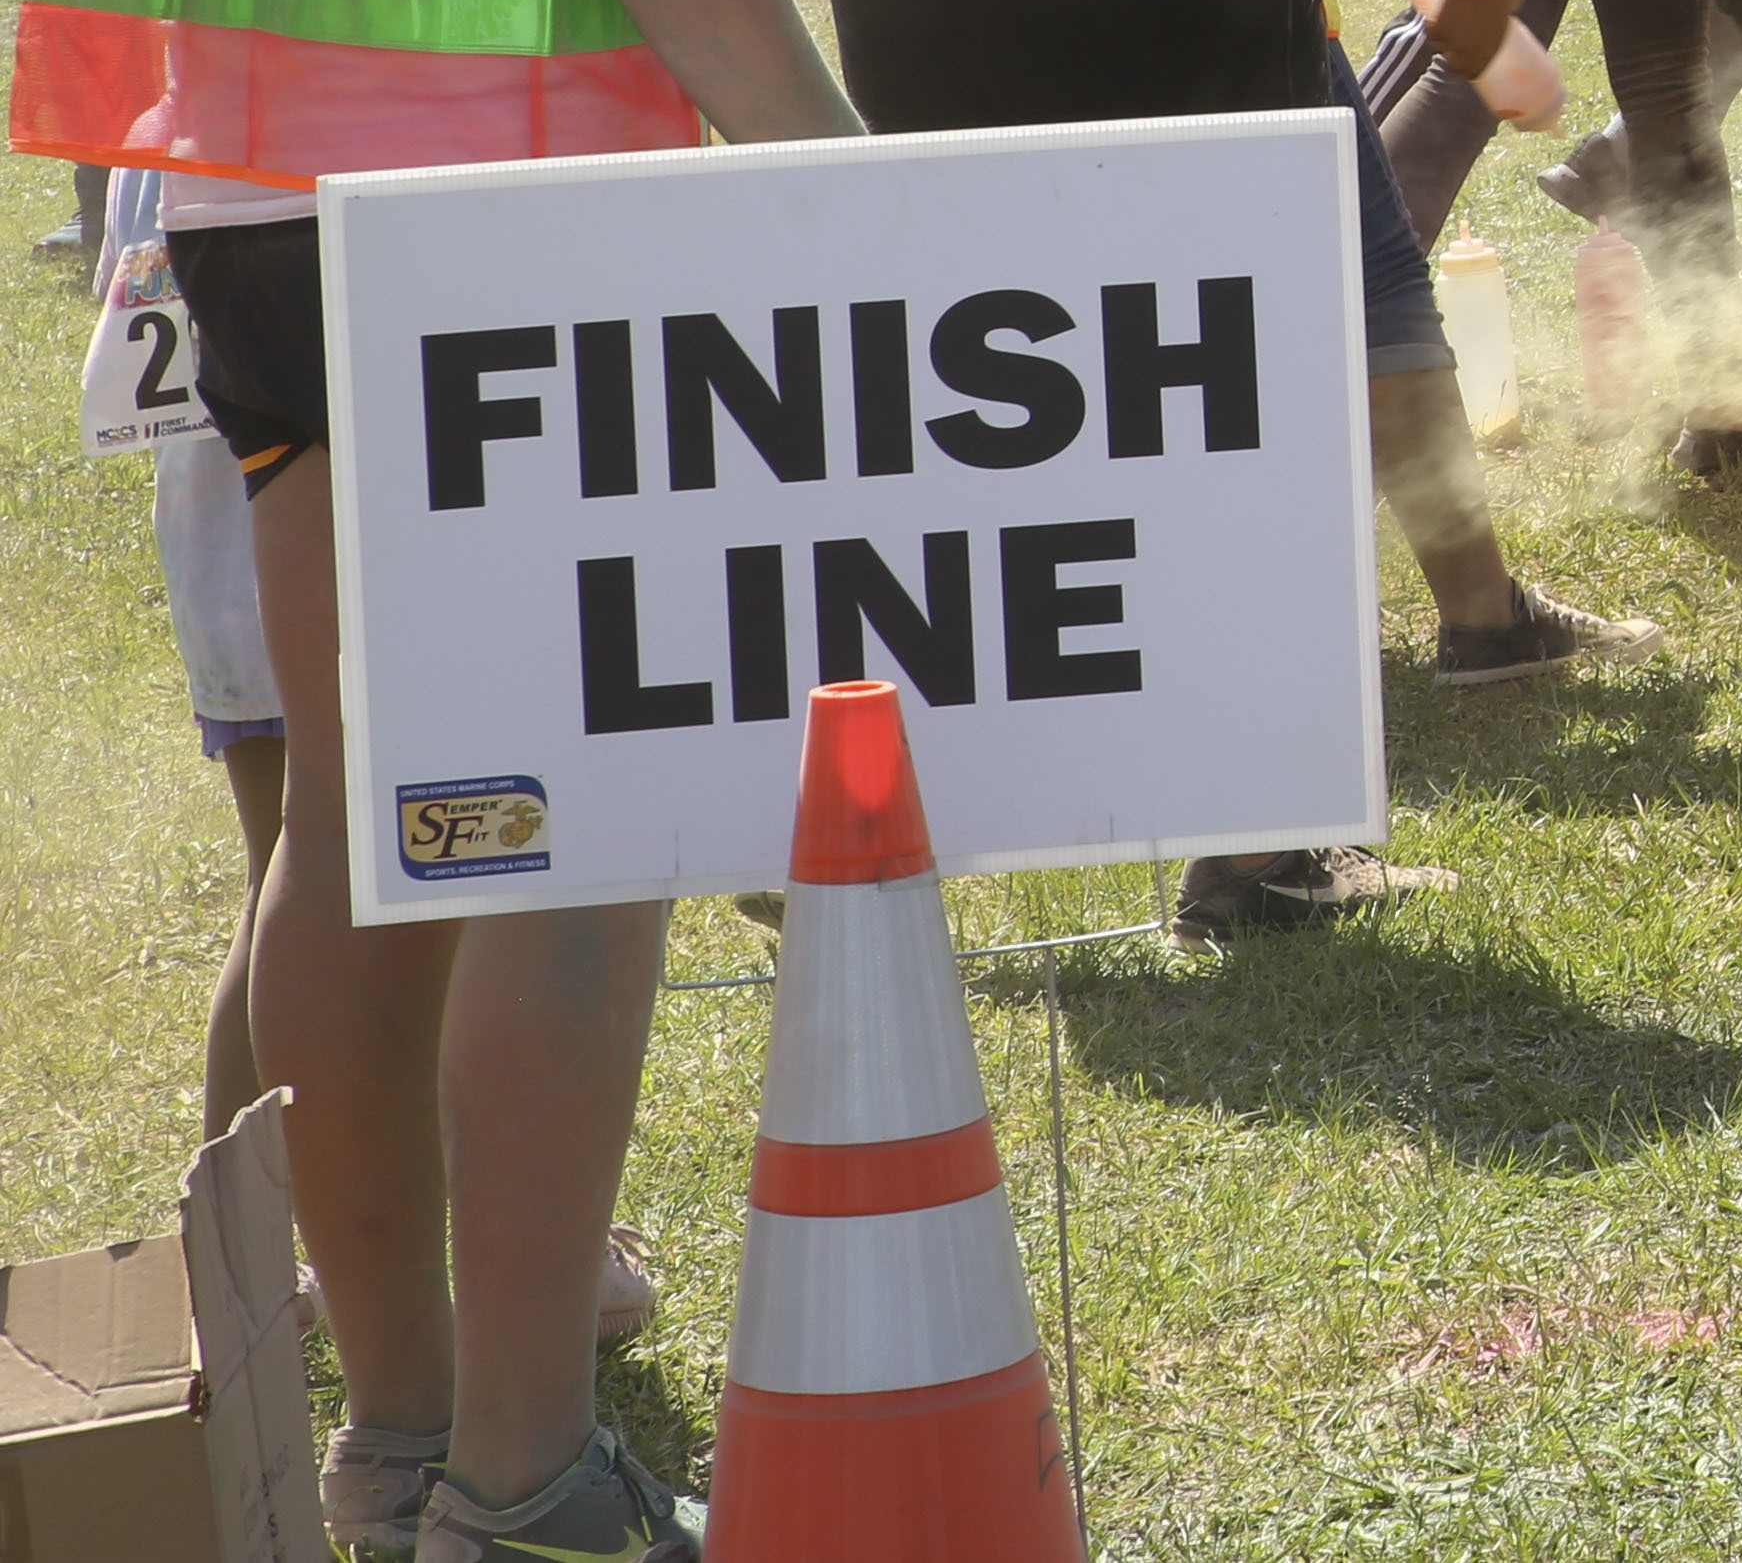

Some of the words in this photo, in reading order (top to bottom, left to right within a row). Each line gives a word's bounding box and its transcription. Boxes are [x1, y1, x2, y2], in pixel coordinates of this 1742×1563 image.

[420, 275, 1261, 512] FINISH
[161, 417, 186, 428] FIRST
[576, 517, 1143, 736] LINE
[400, 788, 427, 798] UNITED
[429, 785, 457, 795] STATES
[458, 782, 487, 792] MARINE
[488, 780, 515, 789] CORPS
[410, 800, 499, 847] SEMPER
[458, 862, 506, 874] RECREATION
[514, 858, 546, 869] FITNESS
